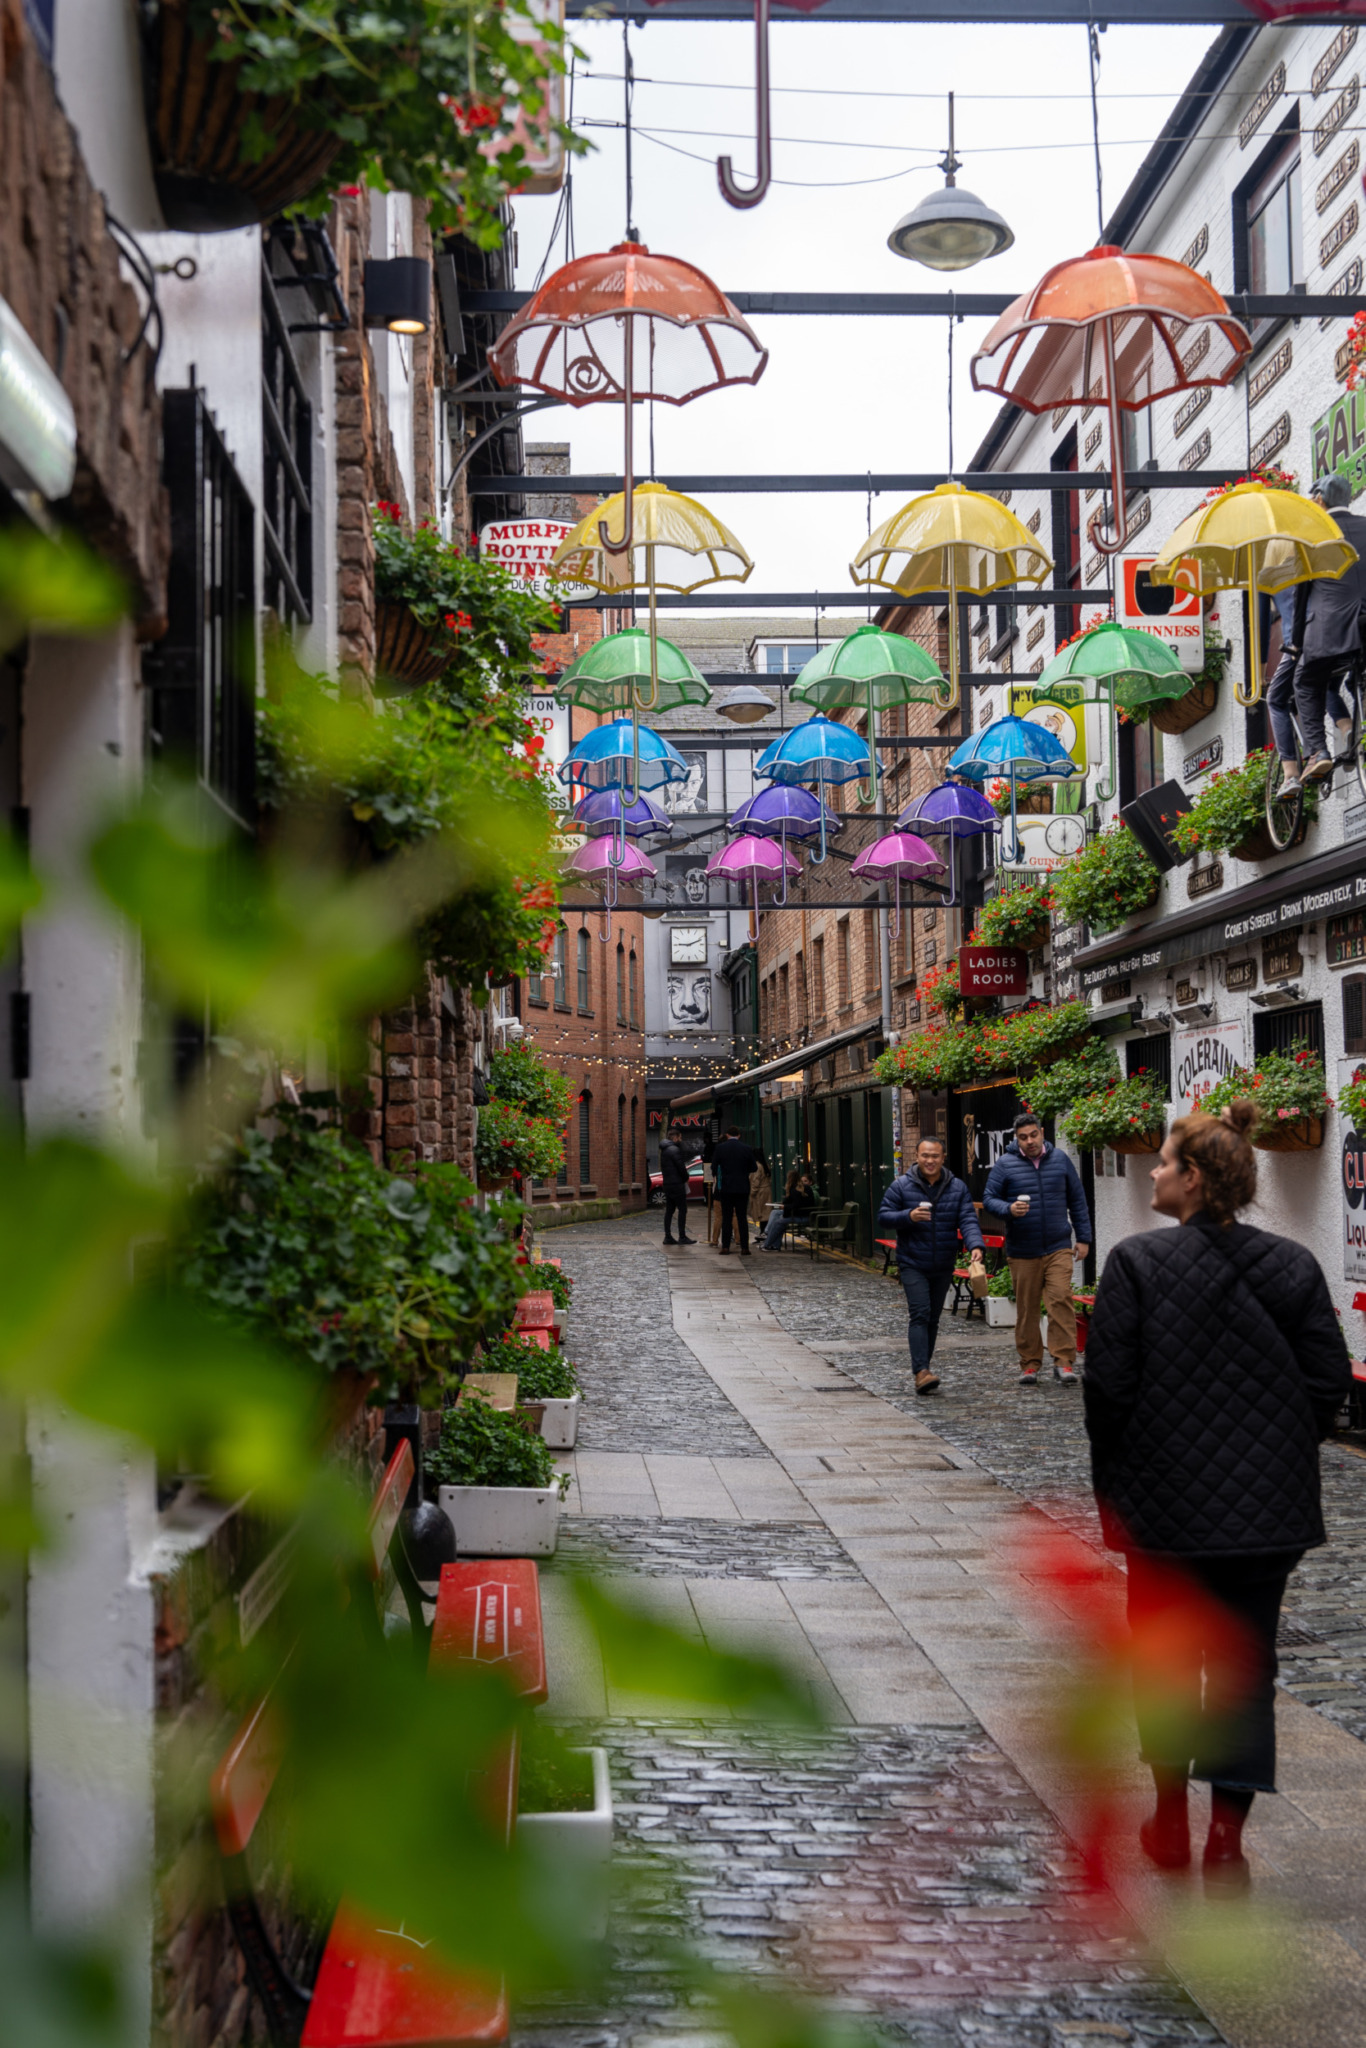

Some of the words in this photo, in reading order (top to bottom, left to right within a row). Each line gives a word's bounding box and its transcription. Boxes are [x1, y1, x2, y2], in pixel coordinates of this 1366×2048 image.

[489, 524, 575, 541] MURPH
[488, 561, 594, 578] UINNESS
[1049, 763, 1071, 773] XPORT
[1225, 923, 1243, 939] COME
[1281, 899, 1302, 922] DRINK
[969, 957, 1017, 968] LADIES
[1269, 953, 1290, 974] DRIVE
[973, 974, 1015, 985] ROOM
